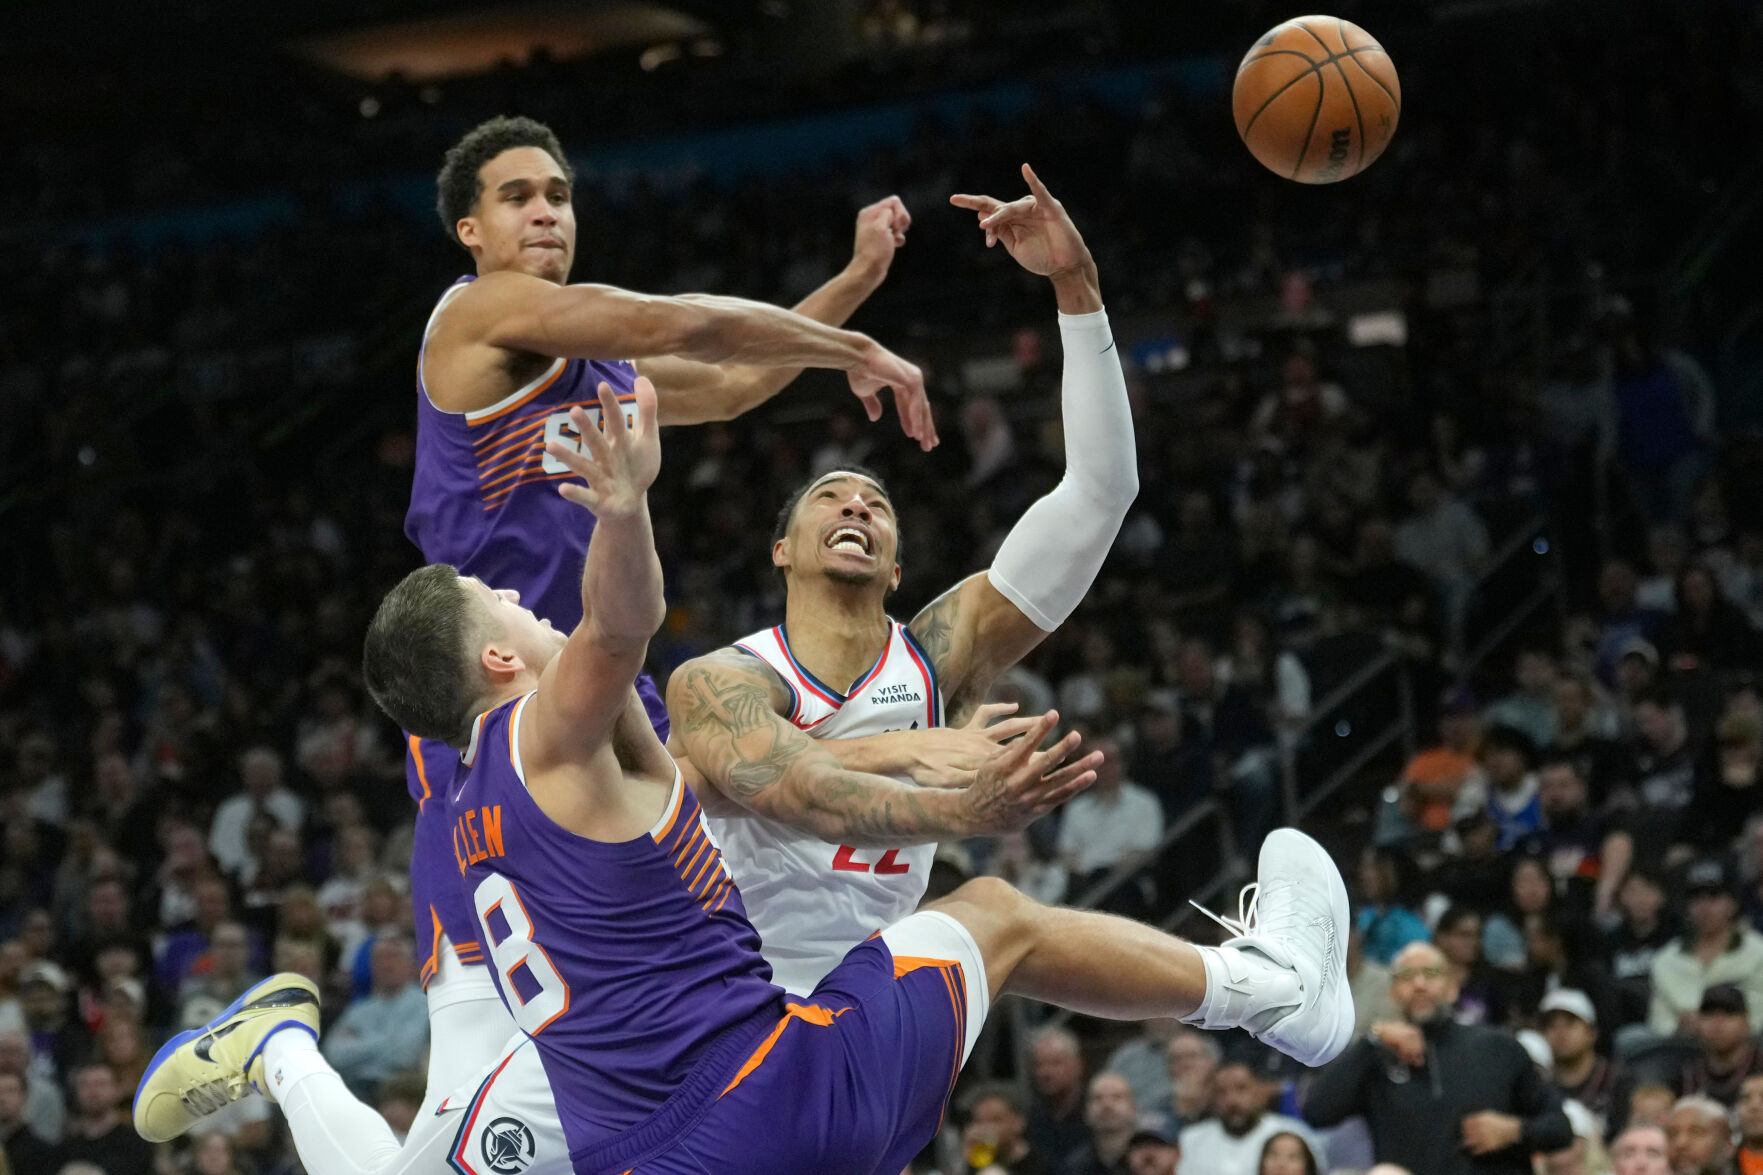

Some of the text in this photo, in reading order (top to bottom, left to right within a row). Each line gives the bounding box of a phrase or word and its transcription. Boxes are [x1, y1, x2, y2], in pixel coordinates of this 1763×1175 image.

[872, 692, 921, 705] RWANDA
[878, 685, 908, 696] VISIT
[453, 805, 505, 879] LLEN
[474, 872, 570, 1037] 8
